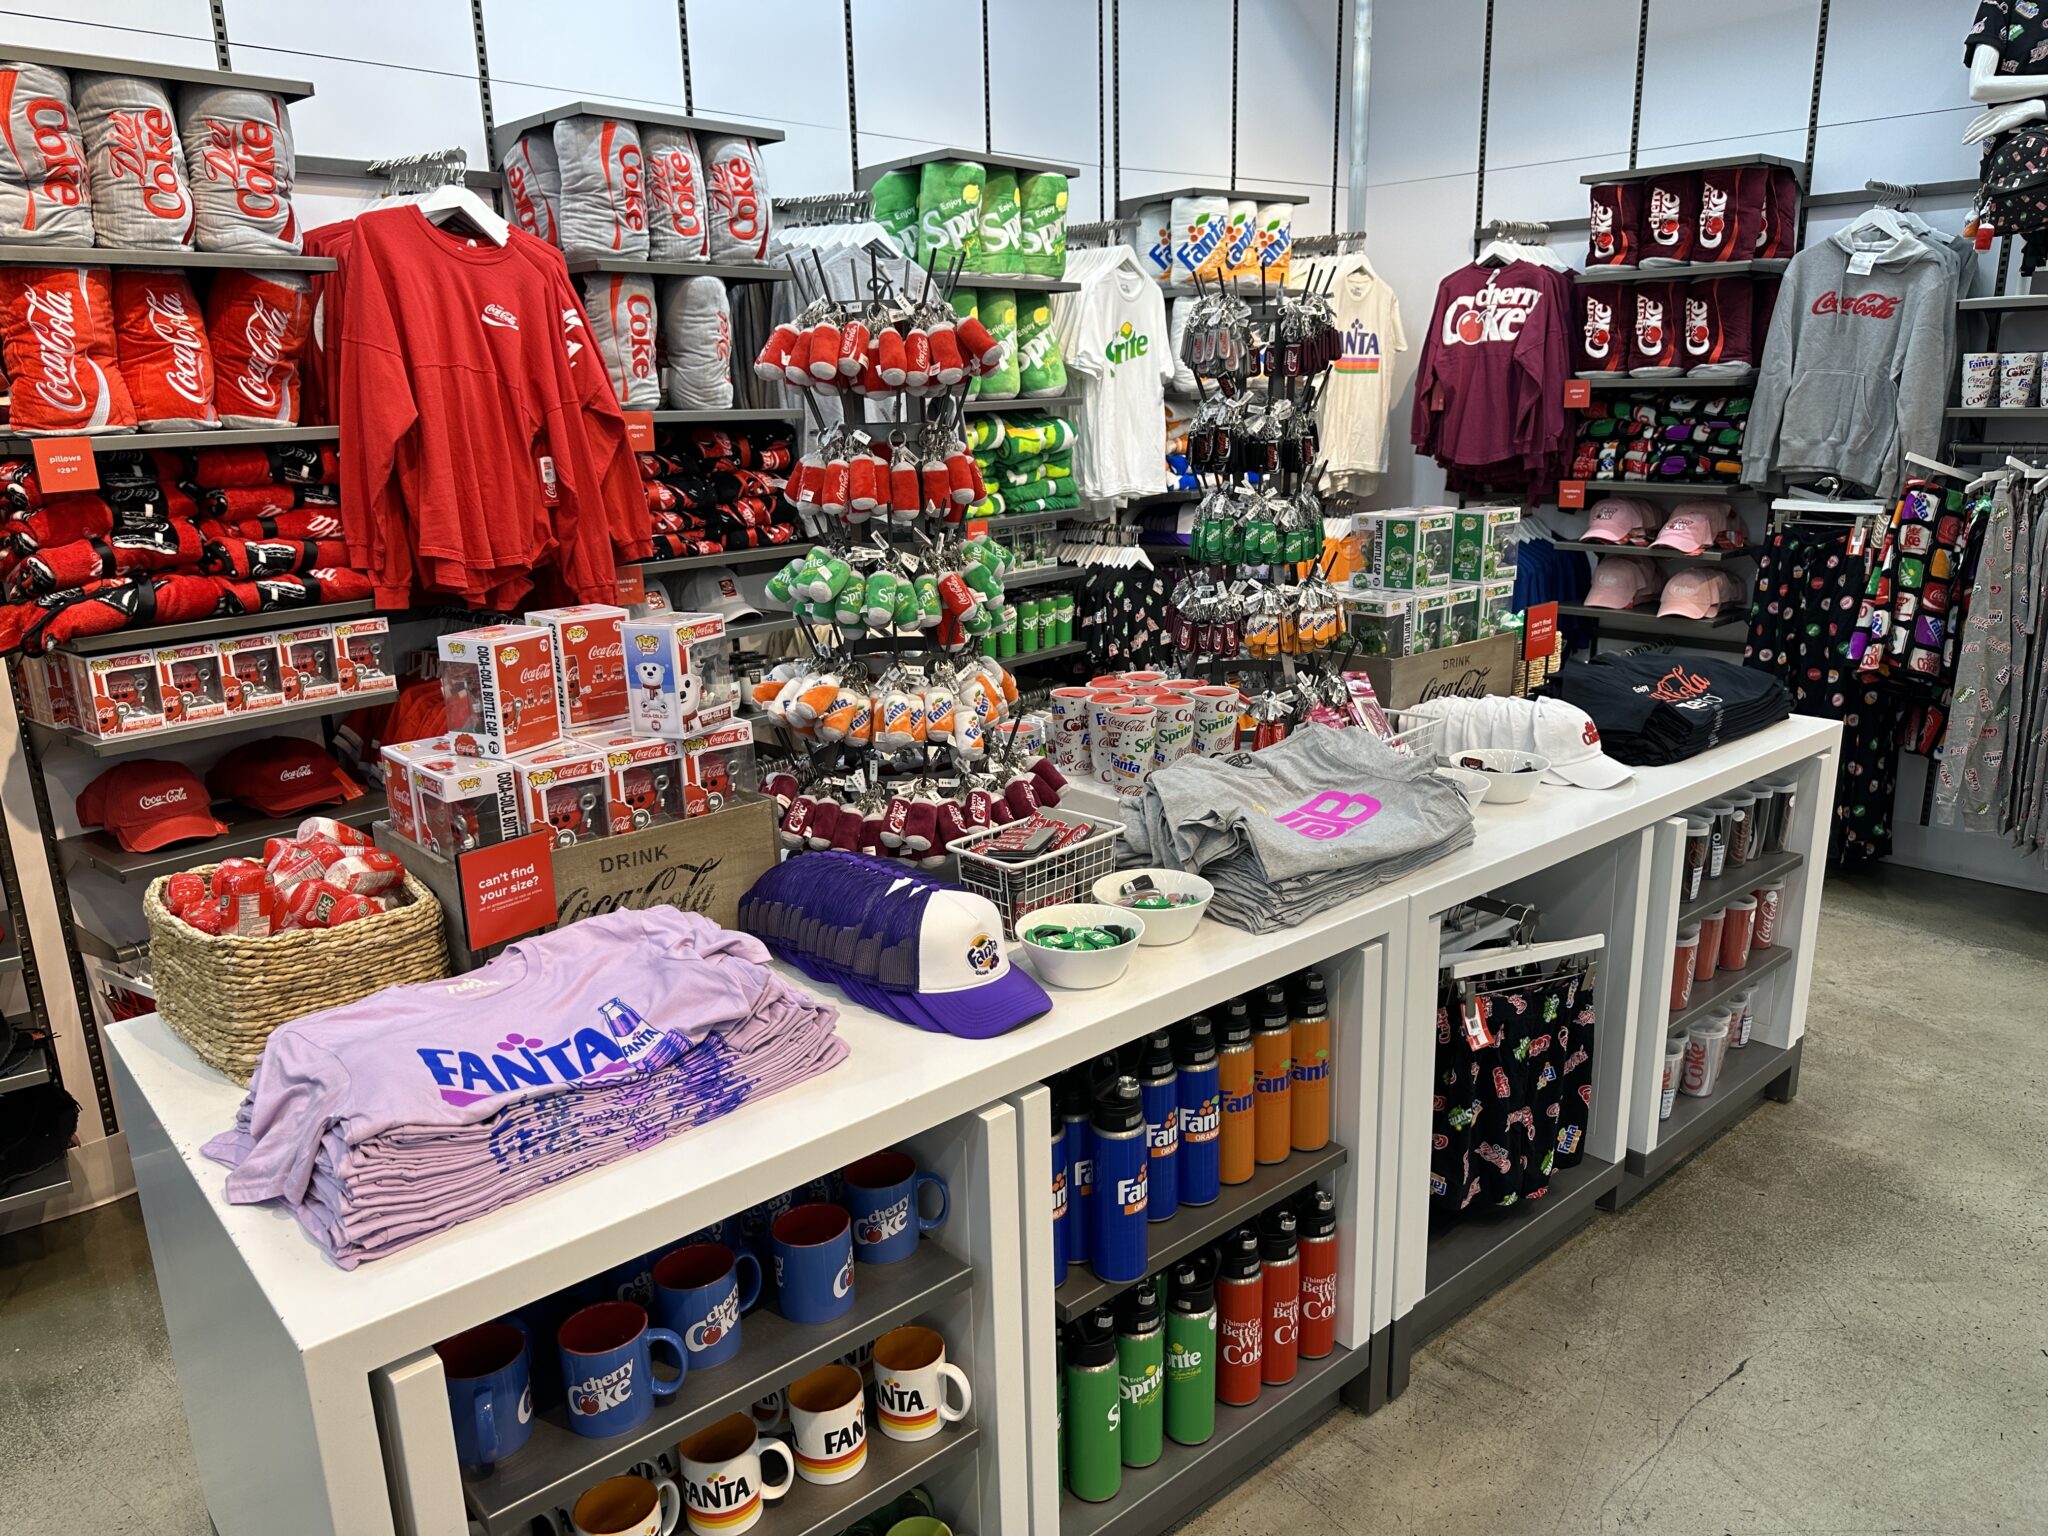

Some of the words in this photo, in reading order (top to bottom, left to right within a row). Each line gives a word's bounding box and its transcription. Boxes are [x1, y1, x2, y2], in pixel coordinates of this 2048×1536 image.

[25, 98, 82, 206] Coke
[108, 112, 145, 186] Diet
[202, 119, 240, 188] Diet
[143, 108, 186, 219] Coke
[236, 121, 280, 218] Coke
[619, 144, 643, 231] Coke
[670, 151, 700, 236] Coke
[728, 158, 758, 240] Coke
[894, 207, 916, 220] Enjoy
[940, 198, 962, 211] Enjoy
[1035, 205, 1055, 219] Enjoy
[1648, 188, 1665, 230] cherry
[1699, 182, 1711, 228] cherry
[1177, 215, 1227, 272] Fanta
[1476, 284, 1543, 314] cherry
[1812, 291, 1903, 319] Coca-Cola
[1442, 296, 1527, 346] Coke
[1584, 295, 1598, 336] cherry
[1636, 293, 1649, 337] cherry
[1685, 297, 1694, 338] cherry
[627, 294, 652, 380] Coke
[1017, 323, 1035, 338] Enjoy
[25, 283, 86, 412] Coca-Cola
[146, 288, 208, 404] Coca-Cola
[238, 295, 289, 407] Coca-Cola
[915, 337, 929, 369] Coca-Cola
[1968, 359, 1993, 369] Fanta
[50, 454, 82, 464] pillows
[477, 645, 492, 689] COCA-COLA
[521, 663, 551, 684] Coca-Cola
[1443, 656, 1471, 670] DRINK
[1420, 666, 1492, 700] Coca-Cola
[1632, 685, 1650, 694] Enjoy
[483, 691, 496, 719] BOTTLE
[1051, 704, 1066, 716] nta
[486, 720, 498, 737] CAP
[709, 731, 735, 745] Coca-Cola
[738, 729, 748, 737] 79
[1109, 717, 1145, 733] Coca-Cola
[1158, 724, 1192, 744] Sprite
[1199, 714, 1234, 734] Sprite
[490, 742, 498, 753] 79
[608, 752, 633, 767] POP!
[635, 747, 662, 760] Coca-Cola
[666, 745, 676, 754] 79
[279, 766, 313, 782] Coca-Cola
[529, 771, 557, 785] POP!
[559, 764, 588, 778] Coca-Cola
[592, 761, 603, 771] 79
[1110, 753, 1140, 774] Fanta
[458, 778, 481, 790] POP!
[497, 772, 514, 815] COCA-COLA
[139, 788, 187, 809] Coca-Cola
[970, 793, 979, 816] cherry
[502, 817, 519, 840] BOTT
[600, 845, 669, 873] DRINK
[478, 872, 509, 889] can't
[511, 863, 535, 879] find
[480, 887, 508, 905] your
[510, 876, 539, 893] size?
[967, 939, 998, 969] Fanta
[622, 1029, 660, 1059] FANTA
[417, 1027, 620, 1092] FANTA
[1682, 1041, 1708, 1092] Coke
[1254, 1071, 1290, 1094] Fant
[1219, 1090, 1254, 1114] Fan
[1179, 1106, 1220, 1134] Fant
[1146, 1123, 1178, 1149] Fan
[1558, 1125, 1579, 1154] Fanta
[1117, 1178, 1147, 1206] Fan
[869, 1194, 912, 1226] cherry
[854, 1209, 908, 1246] Coke
[1305, 1276, 1328, 1284] Things
[1222, 1325, 1260, 1338] Better
[1224, 1318, 1248, 1329] Things
[1274, 1325, 1298, 1346] Co
[1166, 1351, 1202, 1369] prite
[583, 1357, 634, 1394] cherry
[568, 1374, 634, 1417] Coke
[824, 1409, 866, 1456] FAN
